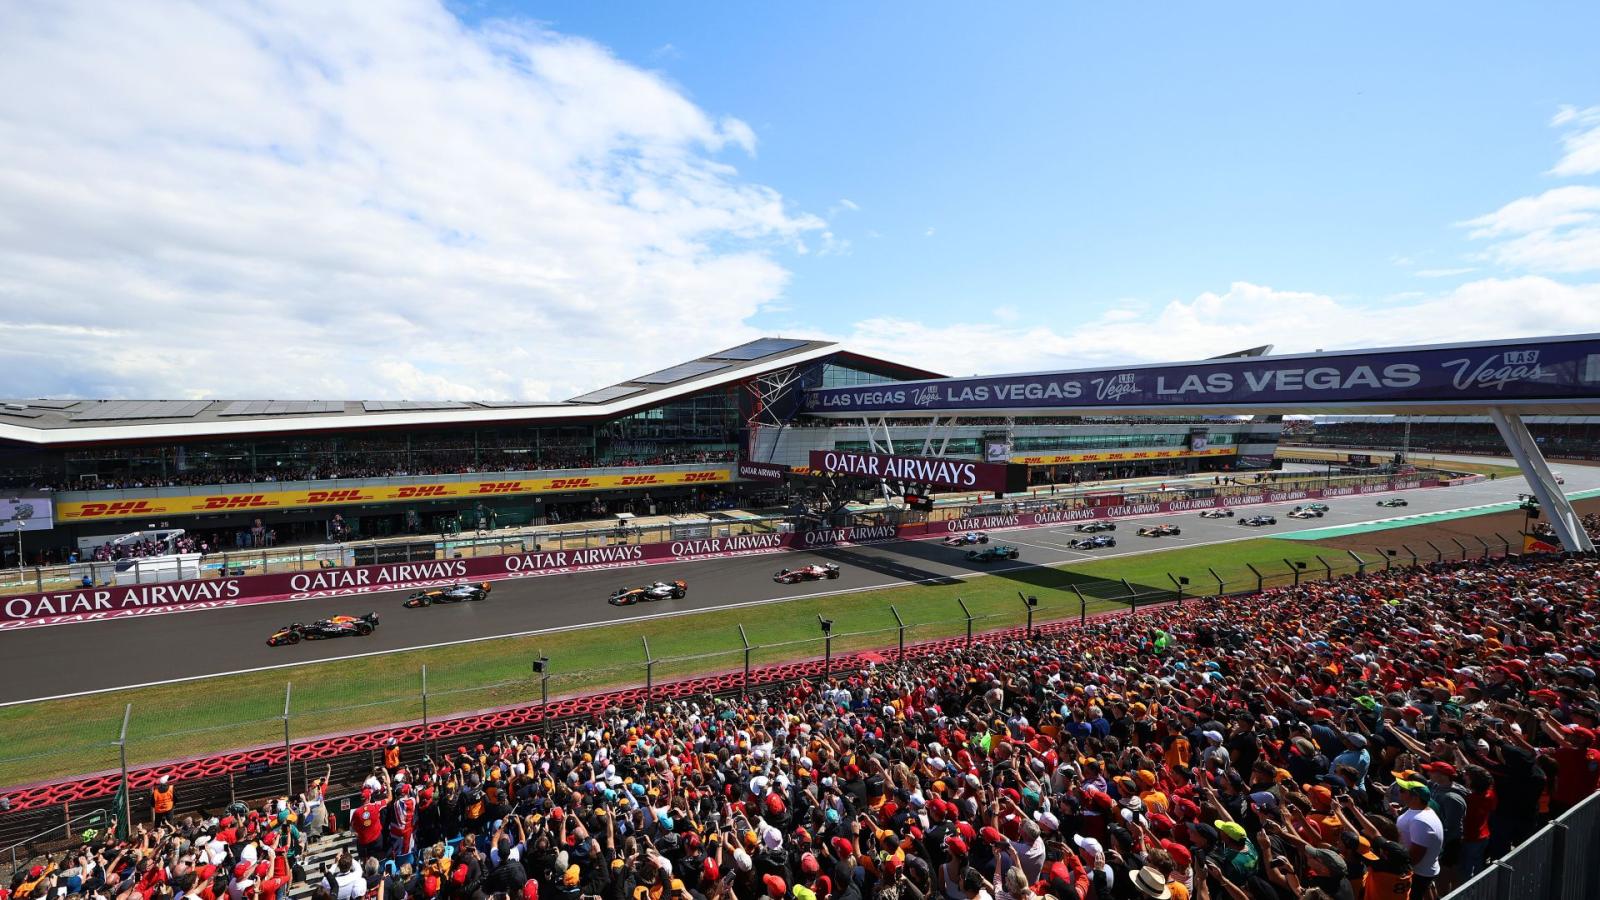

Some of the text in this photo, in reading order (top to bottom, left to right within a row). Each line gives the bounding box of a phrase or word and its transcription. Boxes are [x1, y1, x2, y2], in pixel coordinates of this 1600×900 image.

[1507, 351, 1536, 364] LAS
[1157, 364, 1421, 395] LAS VEGAS
[1441, 355, 1557, 391] Vegas
[947, 381, 1082, 402] LAS VEGAS
[1091, 376, 1142, 401] Vegas
[823, 394, 851, 407] LAS
[854, 391, 906, 405] VEGAS
[740, 465, 757, 476] QATAR
[757, 467, 781, 479] AIRWAYS
[824, 452, 976, 486] QATAR AIRWAYS
[550, 478, 592, 489] DHL
[621, 475, 658, 485] DHL
[685, 472, 718, 482] DHL
[398, 485, 448, 498] DHL
[478, 482, 524, 493] DHL
[205, 495, 267, 509] DHL
[306, 489, 364, 503] DHL
[80, 501, 153, 516] DHL
[1108, 503, 1160, 517] QATAR AIRWAYS
[1169, 498, 1216, 511] QATAR AIRWAYS
[1034, 508, 1095, 523] QATAR AIRWAYS
[947, 515, 1020, 532] QATAR AIRWAYS
[805, 525, 896, 545] QATAR AIRWAYS
[671, 534, 781, 556] QATAR AIRWAYS
[505, 545, 642, 572] QATAR AIRWAYS
[290, 560, 467, 592] QATAR AIRWAYS
[508, 567, 569, 578] QATAR
[289, 578, 470, 599] QATAR AIRWAYS
[5, 579, 240, 618] QATAR AIRWAYS
[0, 599, 238, 628] QATAR AIRWAYS
